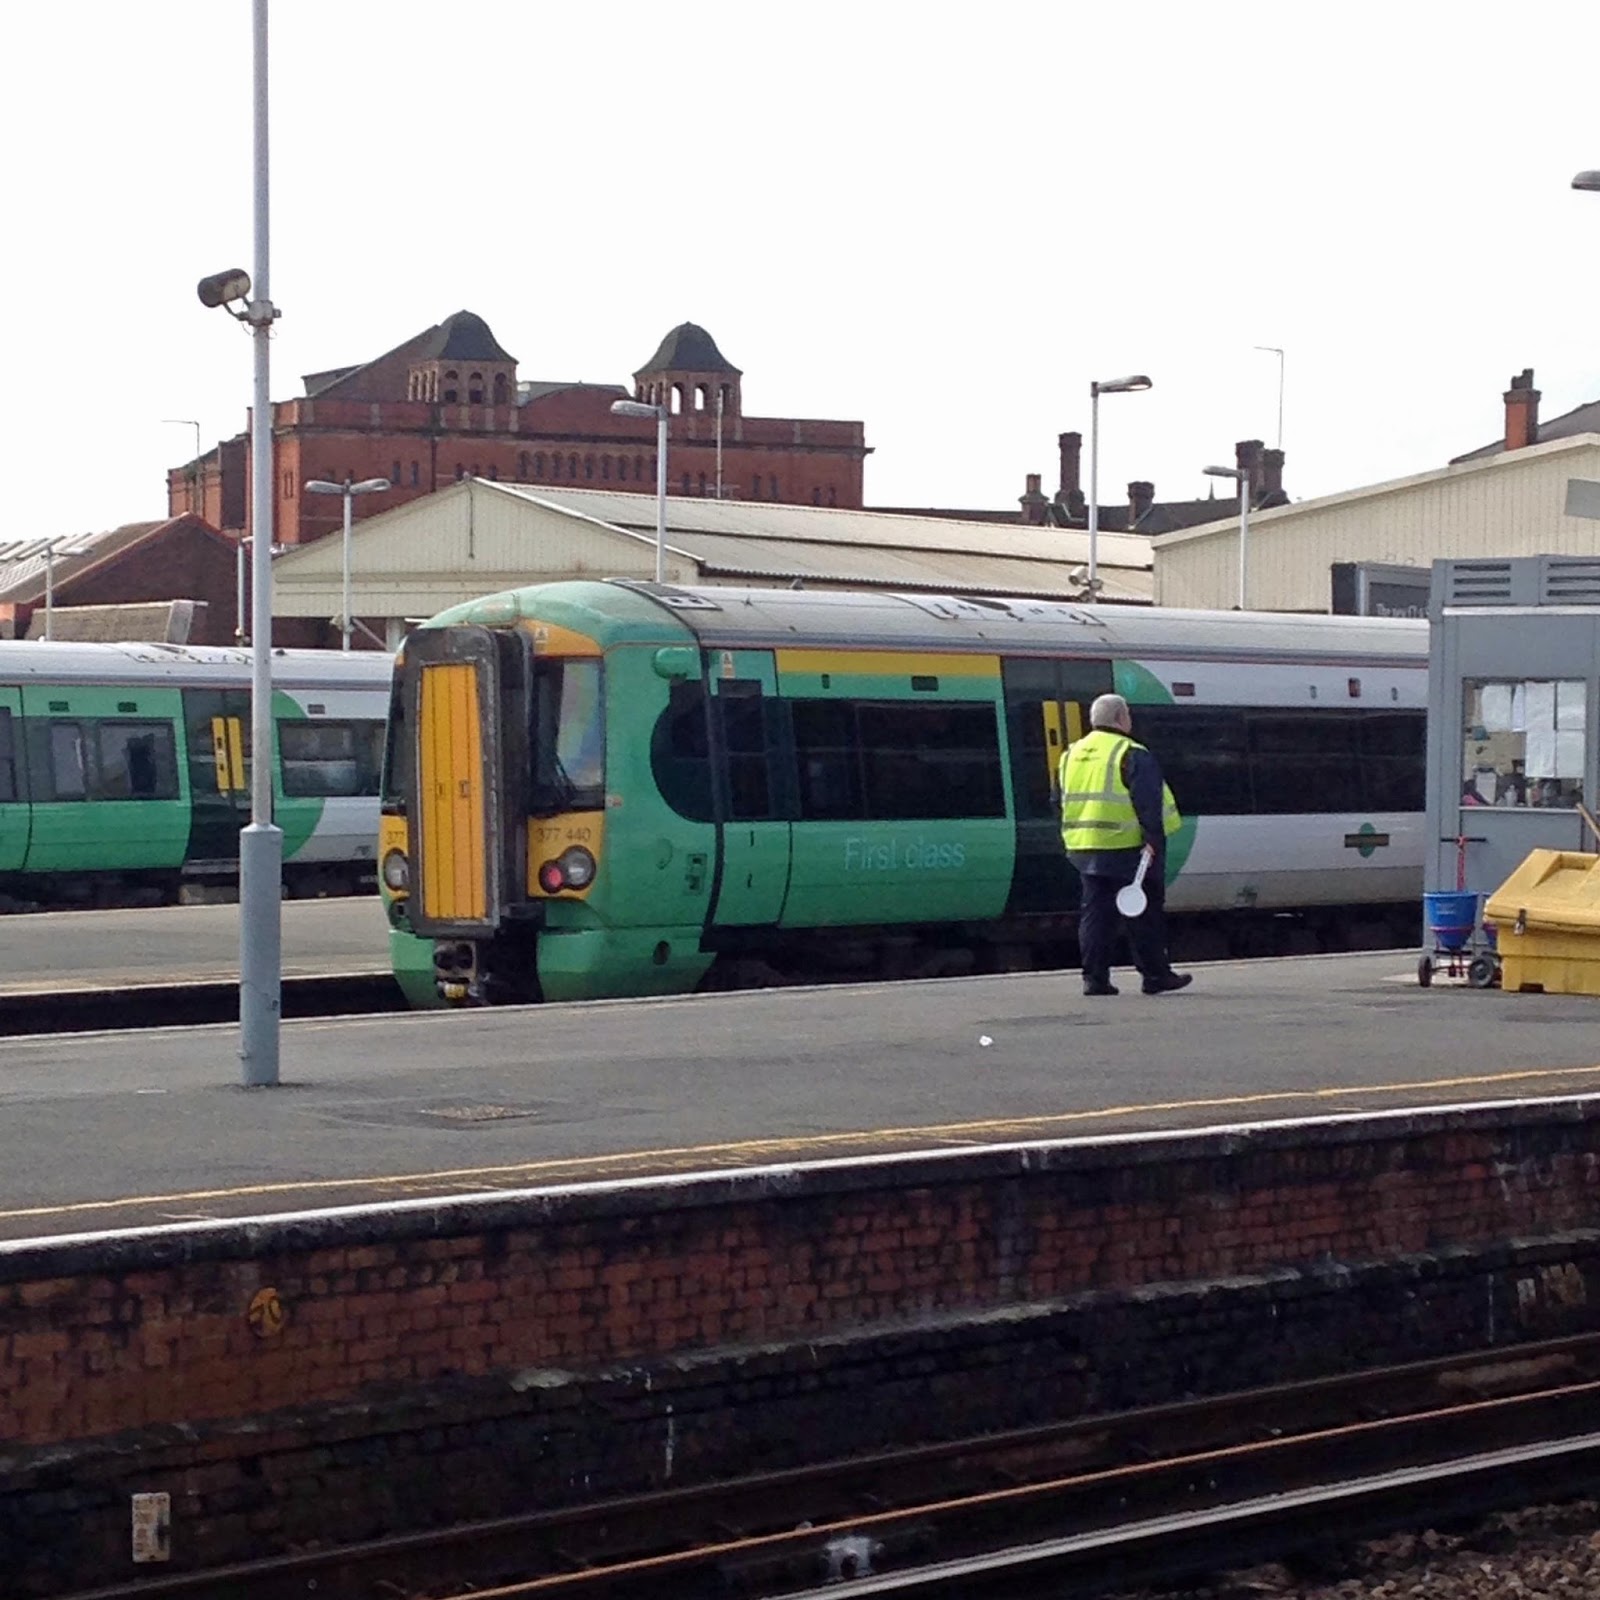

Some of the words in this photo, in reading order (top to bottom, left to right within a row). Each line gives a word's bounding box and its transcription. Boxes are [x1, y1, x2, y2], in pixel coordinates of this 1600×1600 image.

[536, 827, 561, 843] 377
[844, 837, 896, 871] First
[905, 835, 966, 869] class
